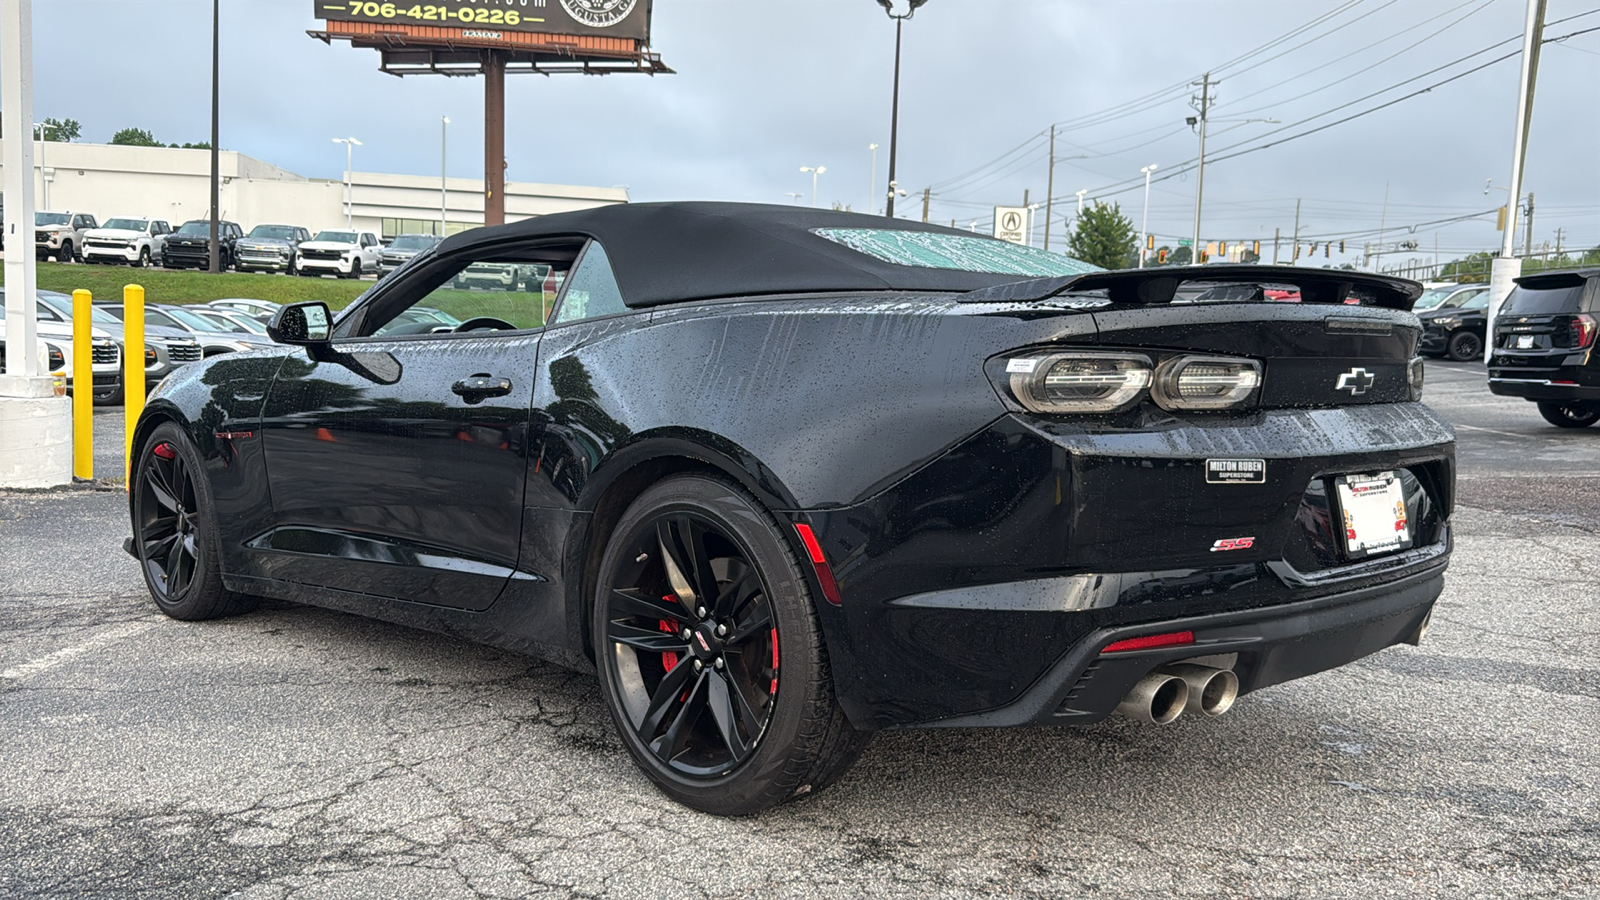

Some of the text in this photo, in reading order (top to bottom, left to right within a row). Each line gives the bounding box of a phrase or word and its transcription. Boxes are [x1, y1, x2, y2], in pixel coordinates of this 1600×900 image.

[349, 1, 520, 25] 706-421-0226
[565, 0, 620, 23] UGUSTA,
[463, 31, 500, 39] LAMAR
[1209, 461, 1262, 472] MILTON RUBEN
[1209, 536, 1256, 552] SS
